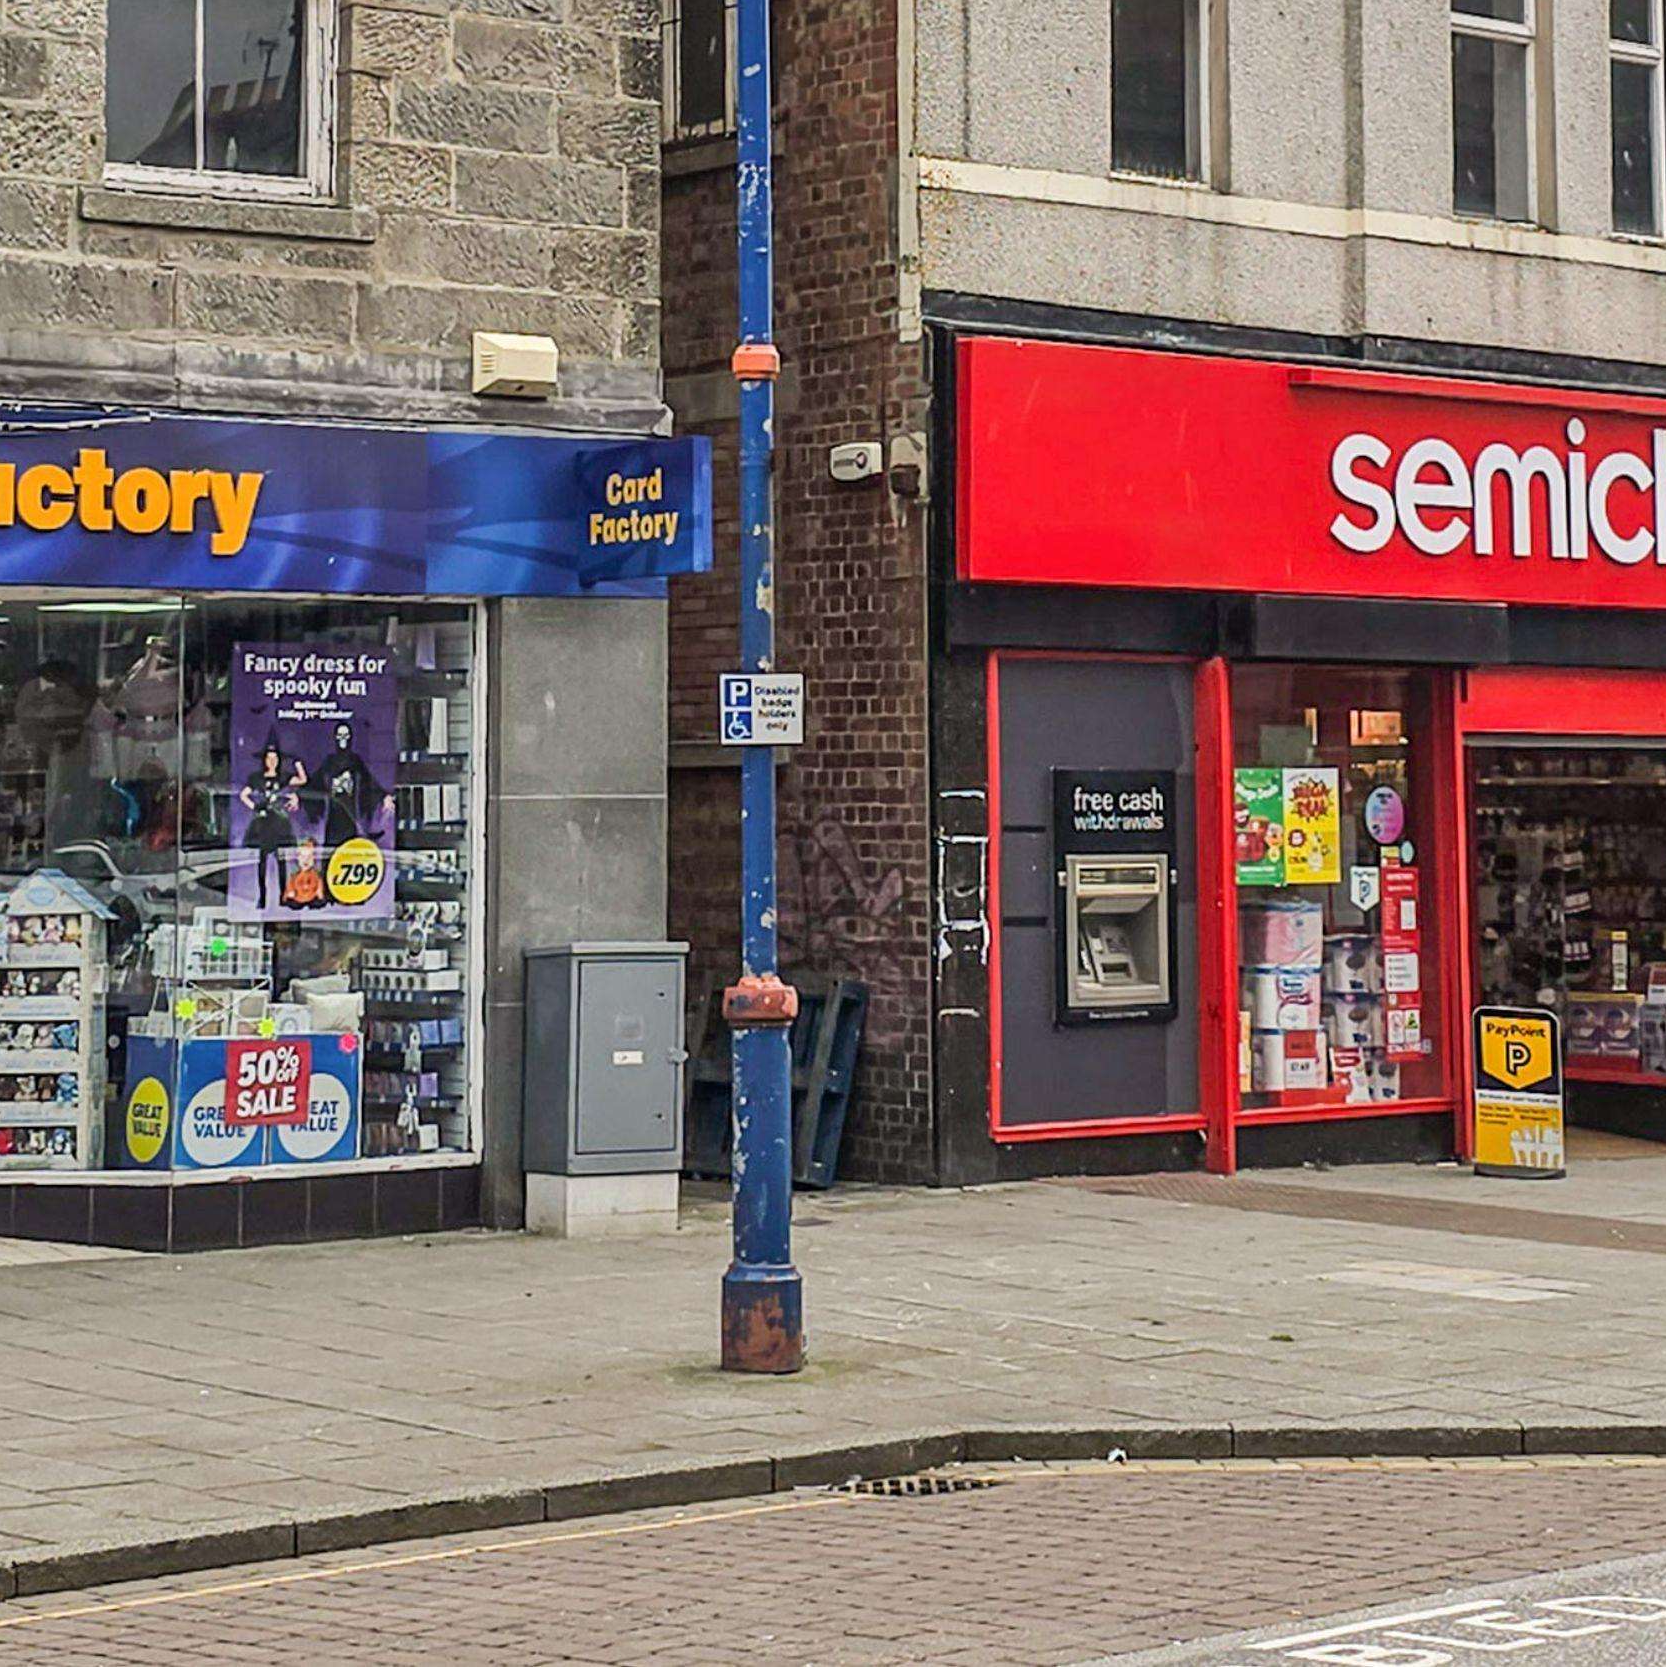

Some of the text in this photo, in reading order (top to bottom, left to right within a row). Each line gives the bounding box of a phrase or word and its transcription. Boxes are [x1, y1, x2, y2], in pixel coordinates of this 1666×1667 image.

[606, 467, 662, 506] Card
[590, 509, 679, 546] Factory
[244, 654, 386, 676] Fancy dress for
[264, 676, 366, 699] spooky fun
[730, 681, 749, 705] P
[1074, 787, 1164, 811] free cash
[1074, 812, 1164, 831] withdrawals
[332, 864, 379, 885] £7.99
[1485, 1022, 1546, 1038] PayPoint
[237, 1046, 300, 1087] 50%
[1506, 1041, 1531, 1076] P
[277, 1067, 299, 1083] OFF
[133, 1102, 163, 1119] GREAT
[237, 1085, 296, 1118] SALE
[310, 1101, 339, 1115] EAT
[194, 1105, 225, 1122] GRE
[133, 1121, 161, 1138] VALUE
[194, 1123, 246, 1138] VALUE
